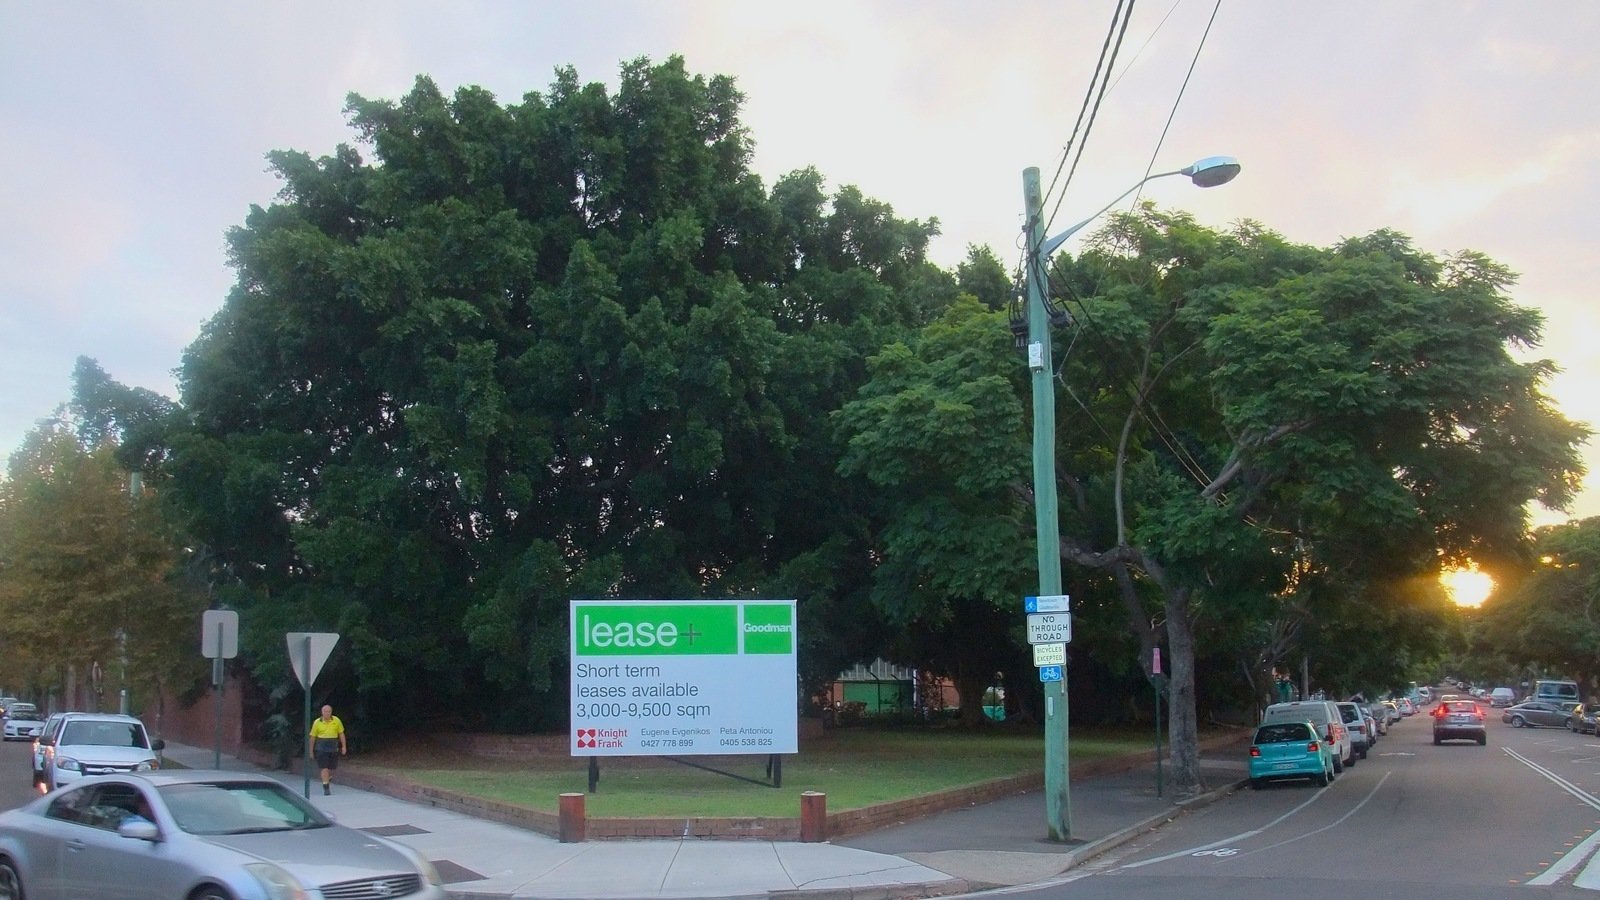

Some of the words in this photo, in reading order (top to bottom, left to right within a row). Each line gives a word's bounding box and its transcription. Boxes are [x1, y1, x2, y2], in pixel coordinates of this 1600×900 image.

[1042, 615, 1055, 623] NO
[744, 622, 792, 633] Goodman
[1030, 624, 1068, 632] THROUGH
[1036, 633, 1062, 641] ROAD
[1036, 646, 1062, 654] BICYCLES
[576, 663, 620, 678] Short
[625, 664, 660, 678] term
[576, 683, 626, 698] leases
[632, 682, 699, 697] available
[576, 702, 671, 719] 3,000-9,500
[676, 703, 711, 719] sqm
[598, 728, 628, 739] Knight
[641, 728, 669, 737] Eugene
[672, 727, 711, 737] Evgenikos
[720, 727, 738, 735] Peta
[739, 727, 774, 735] Antoniou
[598, 739, 623, 748] Frank
[640, 739, 660, 748] 0427
[662, 739, 677, 747] 778
[679, 739, 694, 747] 899
[720, 738, 740, 746] 0405
[741, 738, 756, 746] 538
[758, 738, 773, 746] 825
